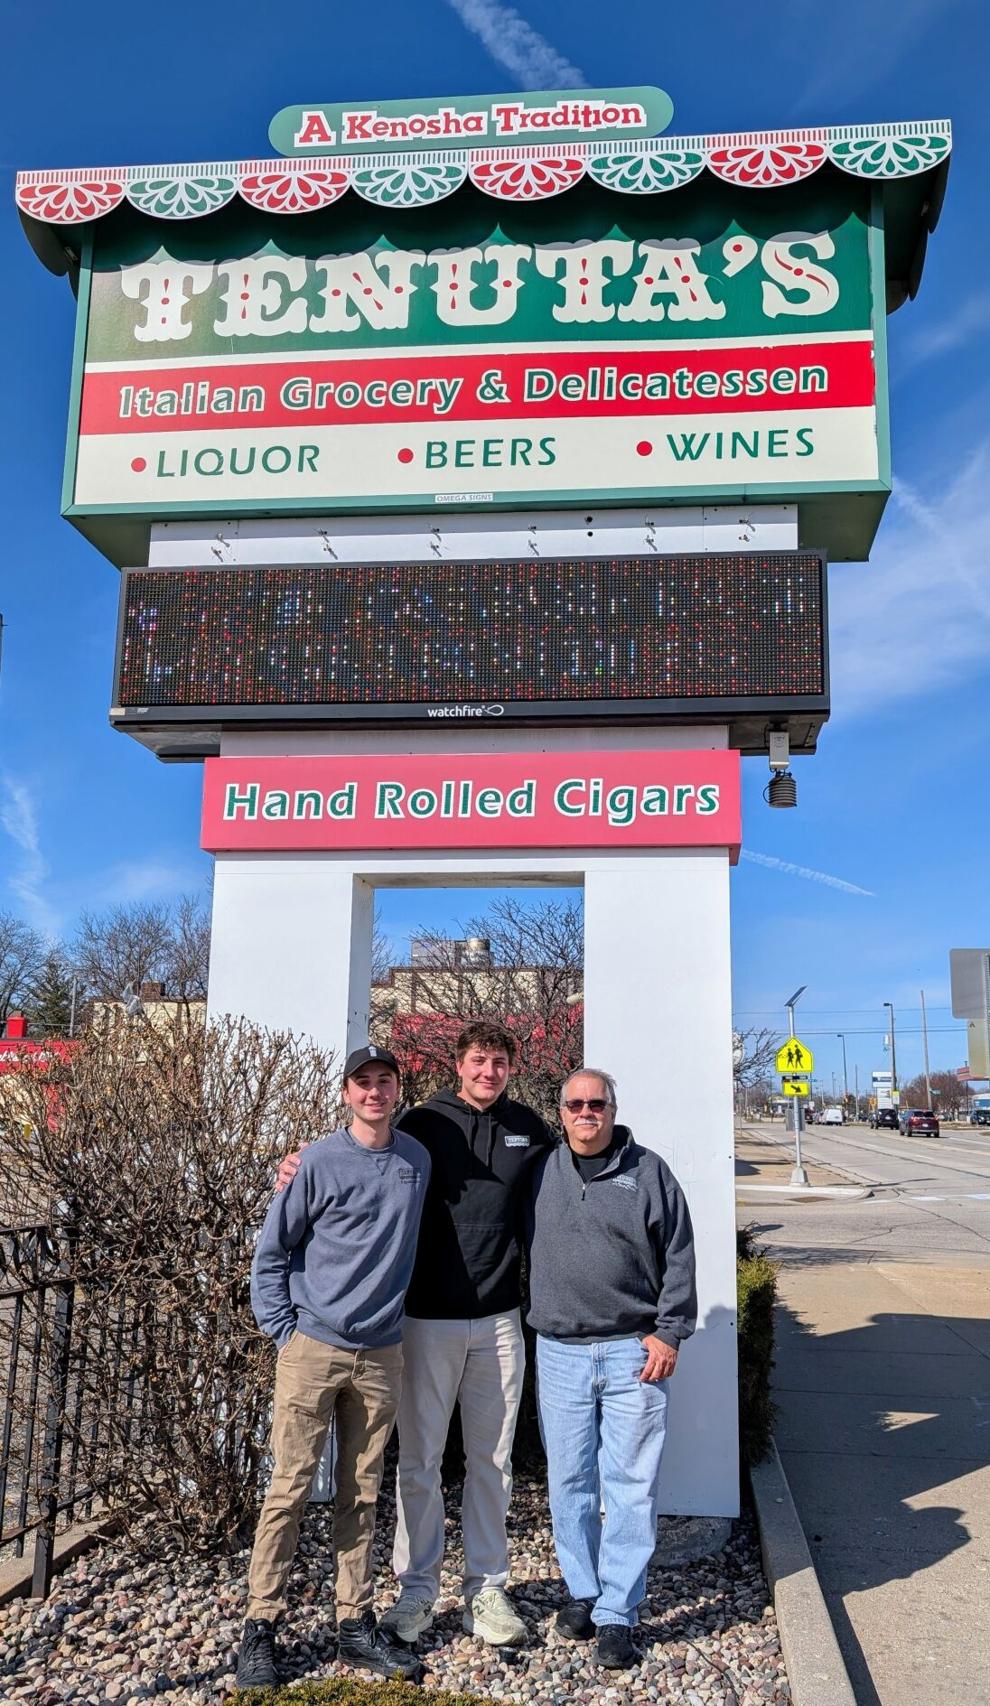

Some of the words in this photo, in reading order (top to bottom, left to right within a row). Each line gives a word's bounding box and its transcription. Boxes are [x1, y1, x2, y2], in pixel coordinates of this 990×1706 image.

[295, 112, 335, 147] A
[342, 108, 487, 144] Kenosha
[492, 101, 646, 134] Tradition
[121, 231, 839, 342] TENUTA'S
[119, 382, 265, 417] Italian
[281, 377, 464, 414] Grocery
[477, 370, 511, 403] &
[524, 365, 828, 402] Delicatessen
[157, 445, 320, 478] LIQUOR
[425, 437, 557, 469] BEERS
[666, 428, 815, 461] WINES
[223, 781, 357, 821] Hand
[374, 780, 536, 819] Rolled
[554, 778, 720, 826] Cigars
